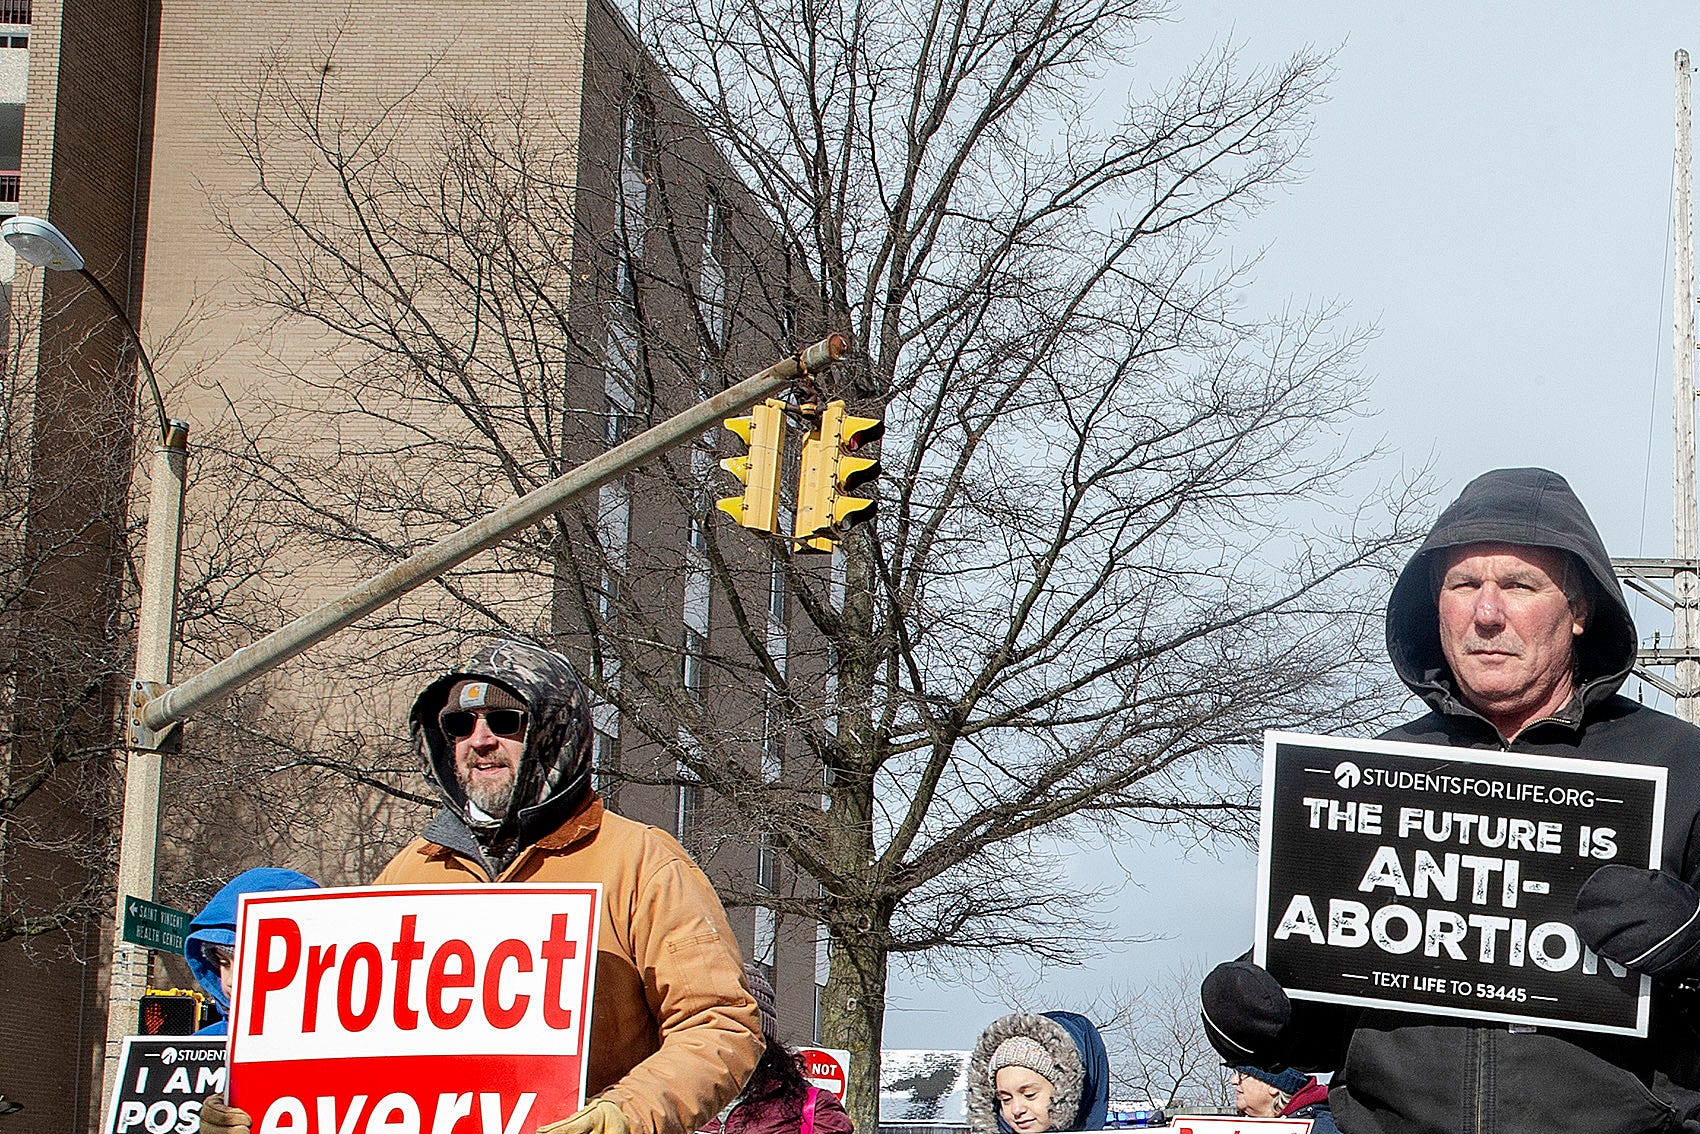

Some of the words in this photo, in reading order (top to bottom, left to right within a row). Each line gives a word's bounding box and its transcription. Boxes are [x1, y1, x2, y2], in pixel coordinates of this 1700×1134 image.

[1362, 767, 1596, 809] STUDENTSFORLIFE.ORG
[1302, 796, 1383, 836] THE
[1398, 806, 1563, 855] FUTURE
[1578, 824, 1619, 861] IS
[1357, 844, 1551, 909] ANTI-
[139, 904, 158, 922] SAINT
[160, 909, 184, 929] VINCENT
[135, 924, 160, 943] HEALTH
[162, 931, 184, 949] CENTER
[247, 912, 578, 1037] Protect
[1372, 971, 1410, 990] TEXT
[1412, 974, 1448, 995] LIFE
[1450, 978, 1472, 997] TO
[1476, 981, 1528, 1003] 53445
[135, 1066, 150, 1094] I
[162, 1066, 227, 1094] AM
[812, 1063, 838, 1077] NOT
